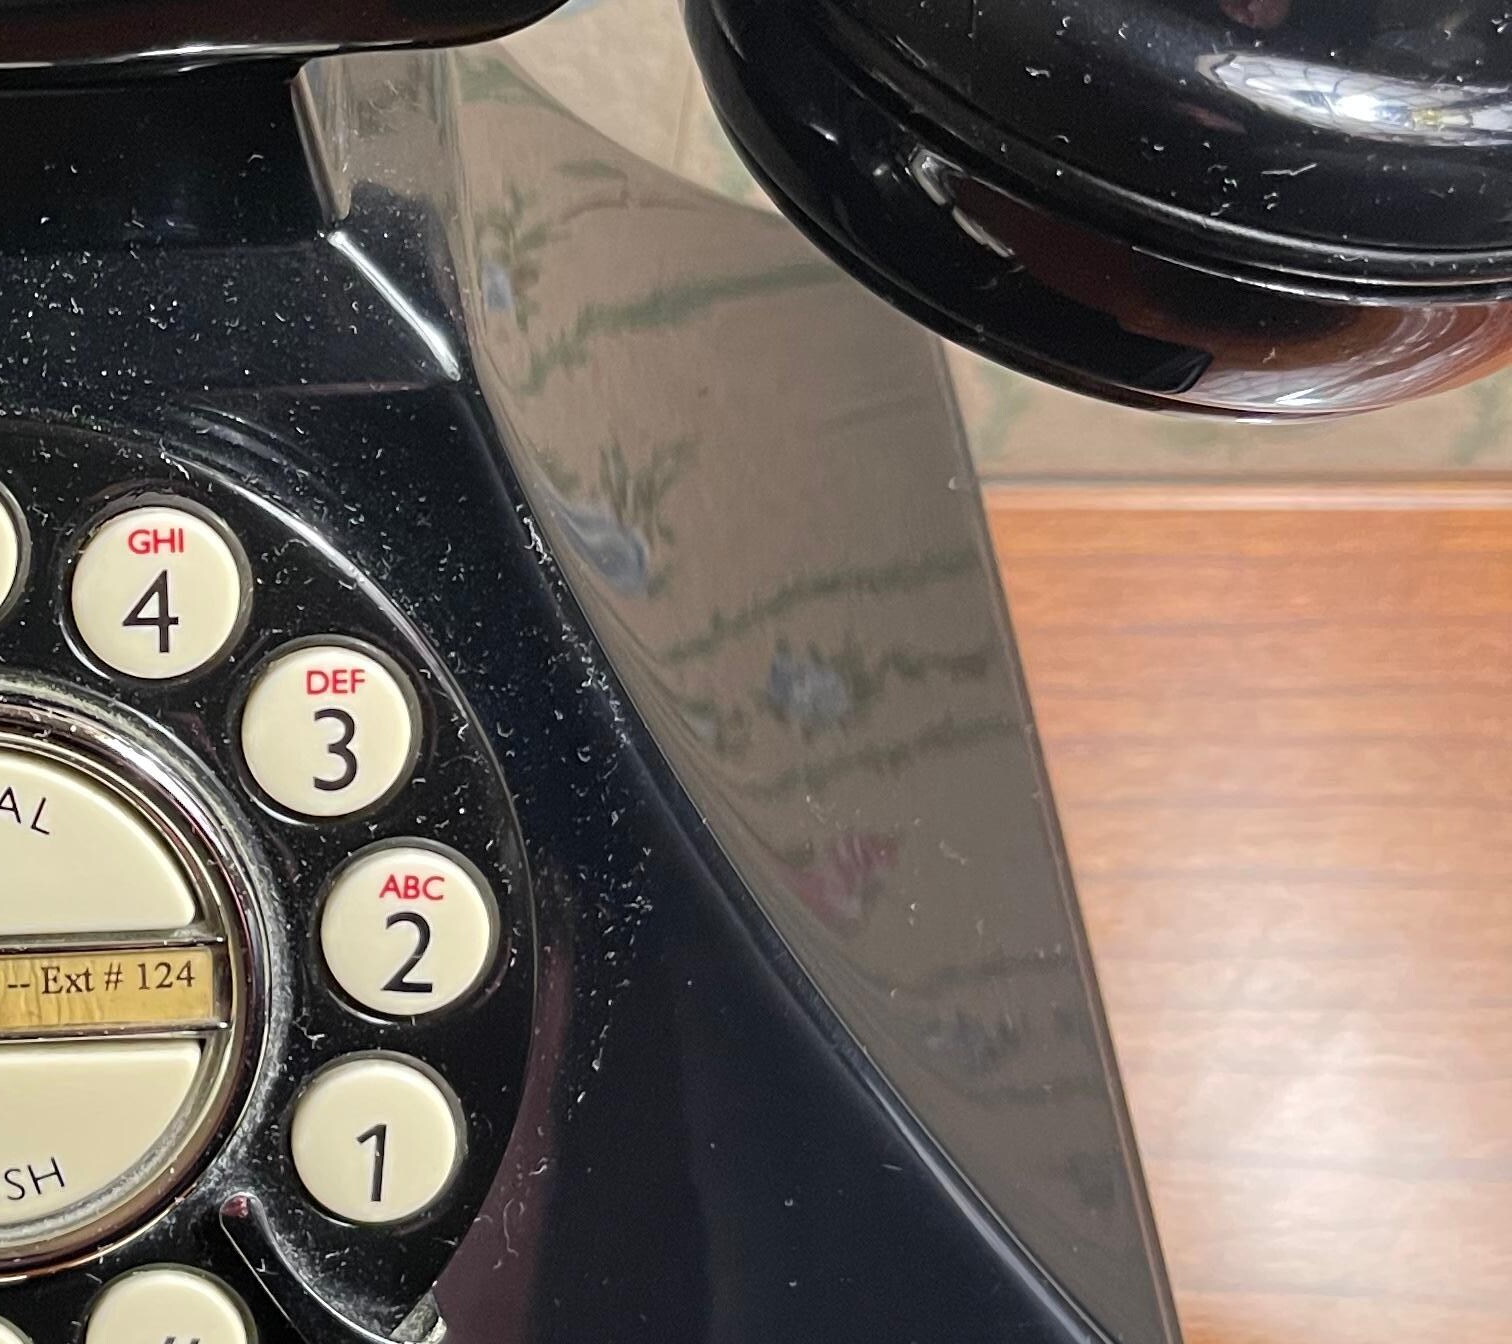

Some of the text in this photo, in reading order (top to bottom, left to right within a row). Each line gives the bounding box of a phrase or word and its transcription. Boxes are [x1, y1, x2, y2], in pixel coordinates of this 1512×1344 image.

[126, 527, 185, 556] GHI
[122, 569, 179, 654] 4
[305, 668, 364, 696] DEF
[313, 708, 358, 792] 3
[378, 874, 445, 901] ABC
[41, 965, 95, 995] Ext
[104, 962, 125, 989] #
[136, 960, 196, 991] 124
[381, 911, 433, 994] 2
[357, 1124, 387, 1203] 1
